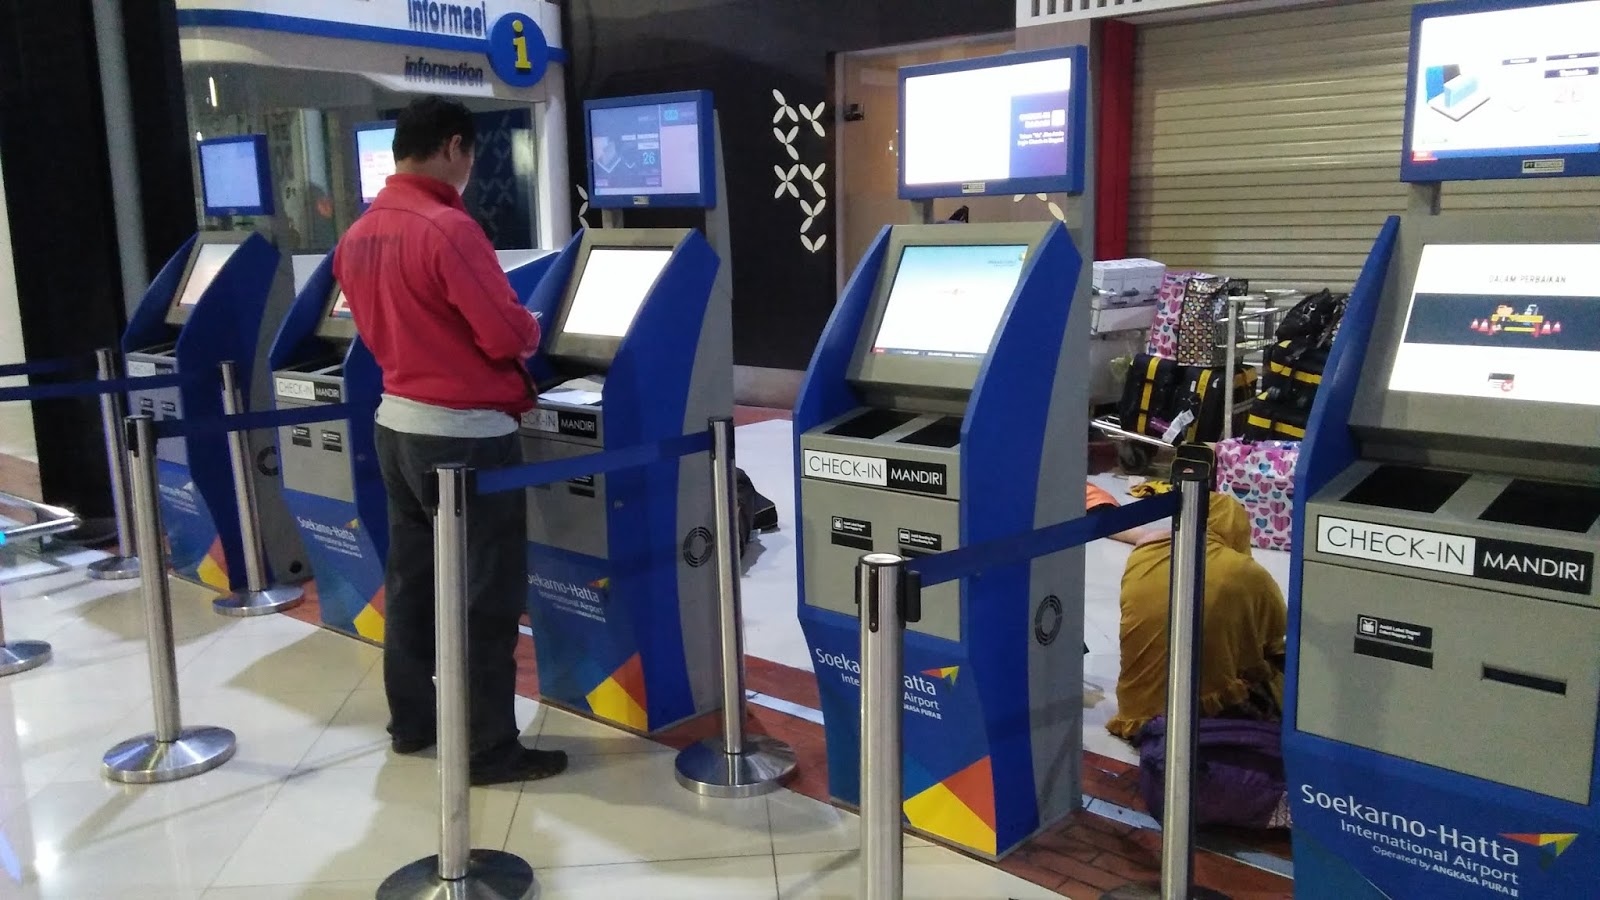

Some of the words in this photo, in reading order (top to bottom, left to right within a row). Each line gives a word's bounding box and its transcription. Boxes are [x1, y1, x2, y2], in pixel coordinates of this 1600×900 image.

[404, 56, 483, 86] information
[560, 418, 595, 432] MANDIRI
[809, 455, 883, 479] CHECK-IN
[890, 467, 943, 486] MANDIRI
[1327, 525, 1466, 566] CHECK-IN
[1483, 550, 1585, 582] MANDIRI
[904, 691, 940, 710] Airport
[1301, 783, 1519, 866] Soekarno-Hatta
[1341, 818, 1448, 863] International
[1453, 855, 1519, 885] Airport
[1372, 845, 1417, 866] Operated
[1419, 859, 1431, 871] by
[1432, 863, 1479, 885] ANGKASA
[1481, 879, 1509, 895] PURA
